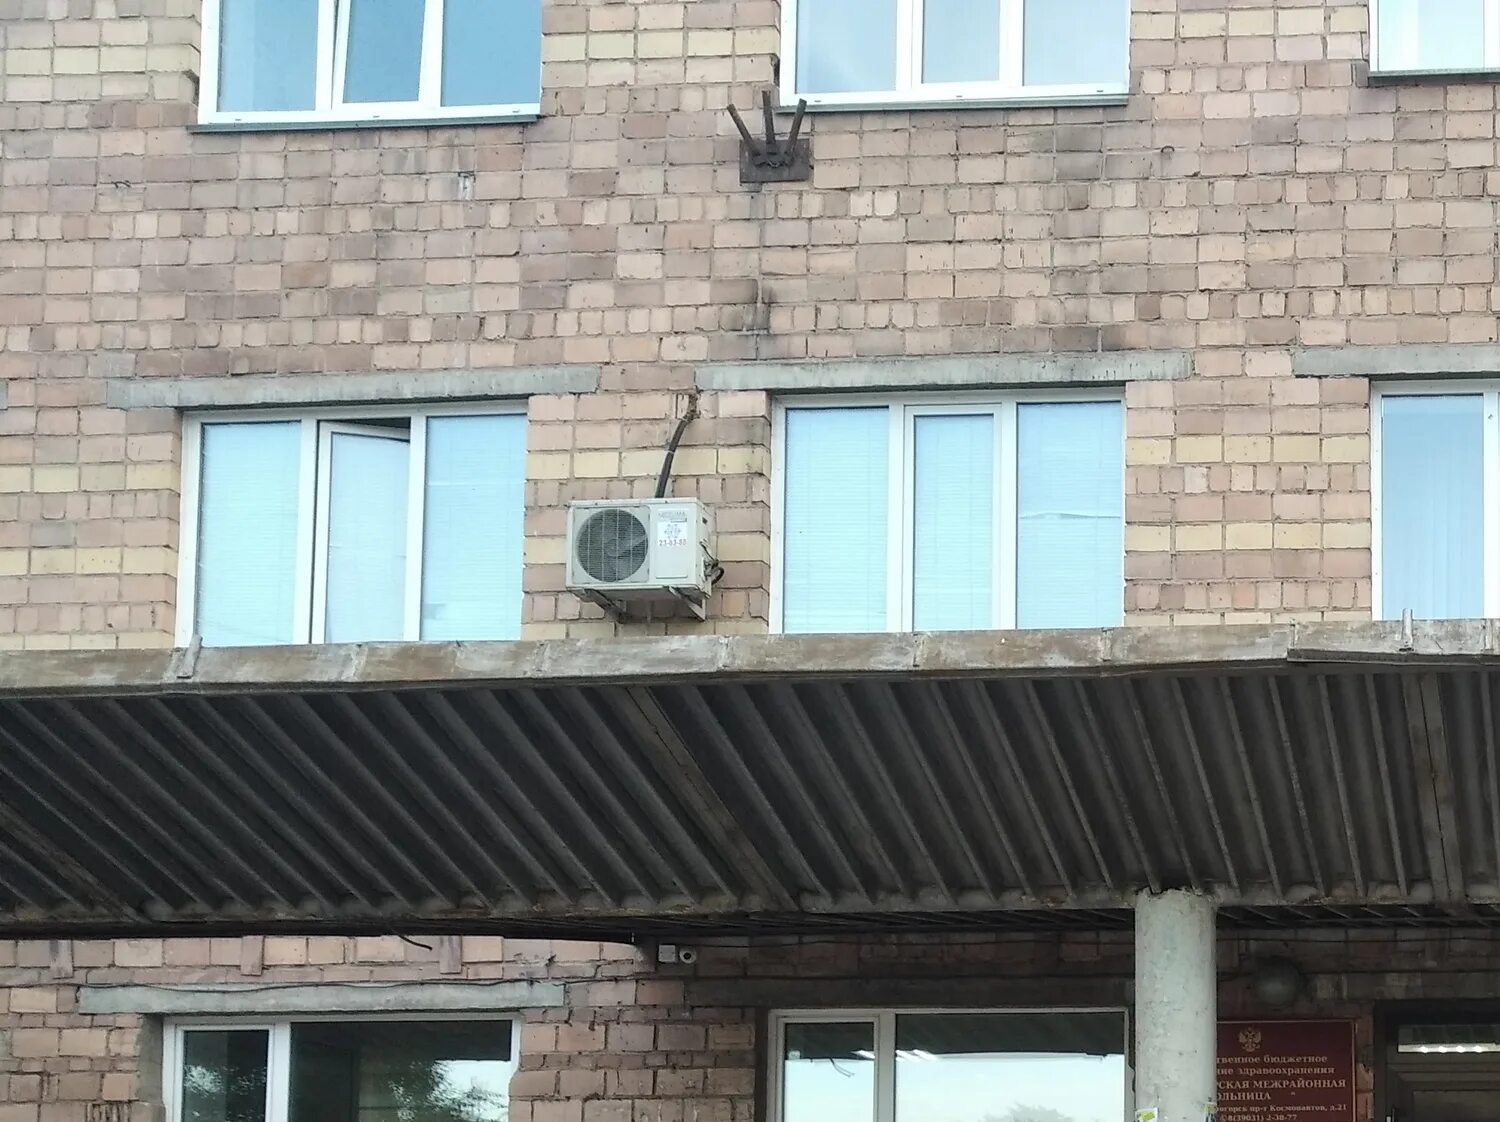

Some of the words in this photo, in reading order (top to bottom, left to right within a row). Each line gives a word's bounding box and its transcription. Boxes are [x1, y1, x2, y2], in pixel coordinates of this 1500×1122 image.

[1216, 1055, 1260, 1064] твенное
[1263, 1054, 1328, 1064] бюджетное
[1240, 1066, 1335, 1077] здравоохранения
[1217, 1079, 1250, 1090] СКАЯ
[1253, 1077, 1347, 1089] МЕЖРАЙОННАЯ
